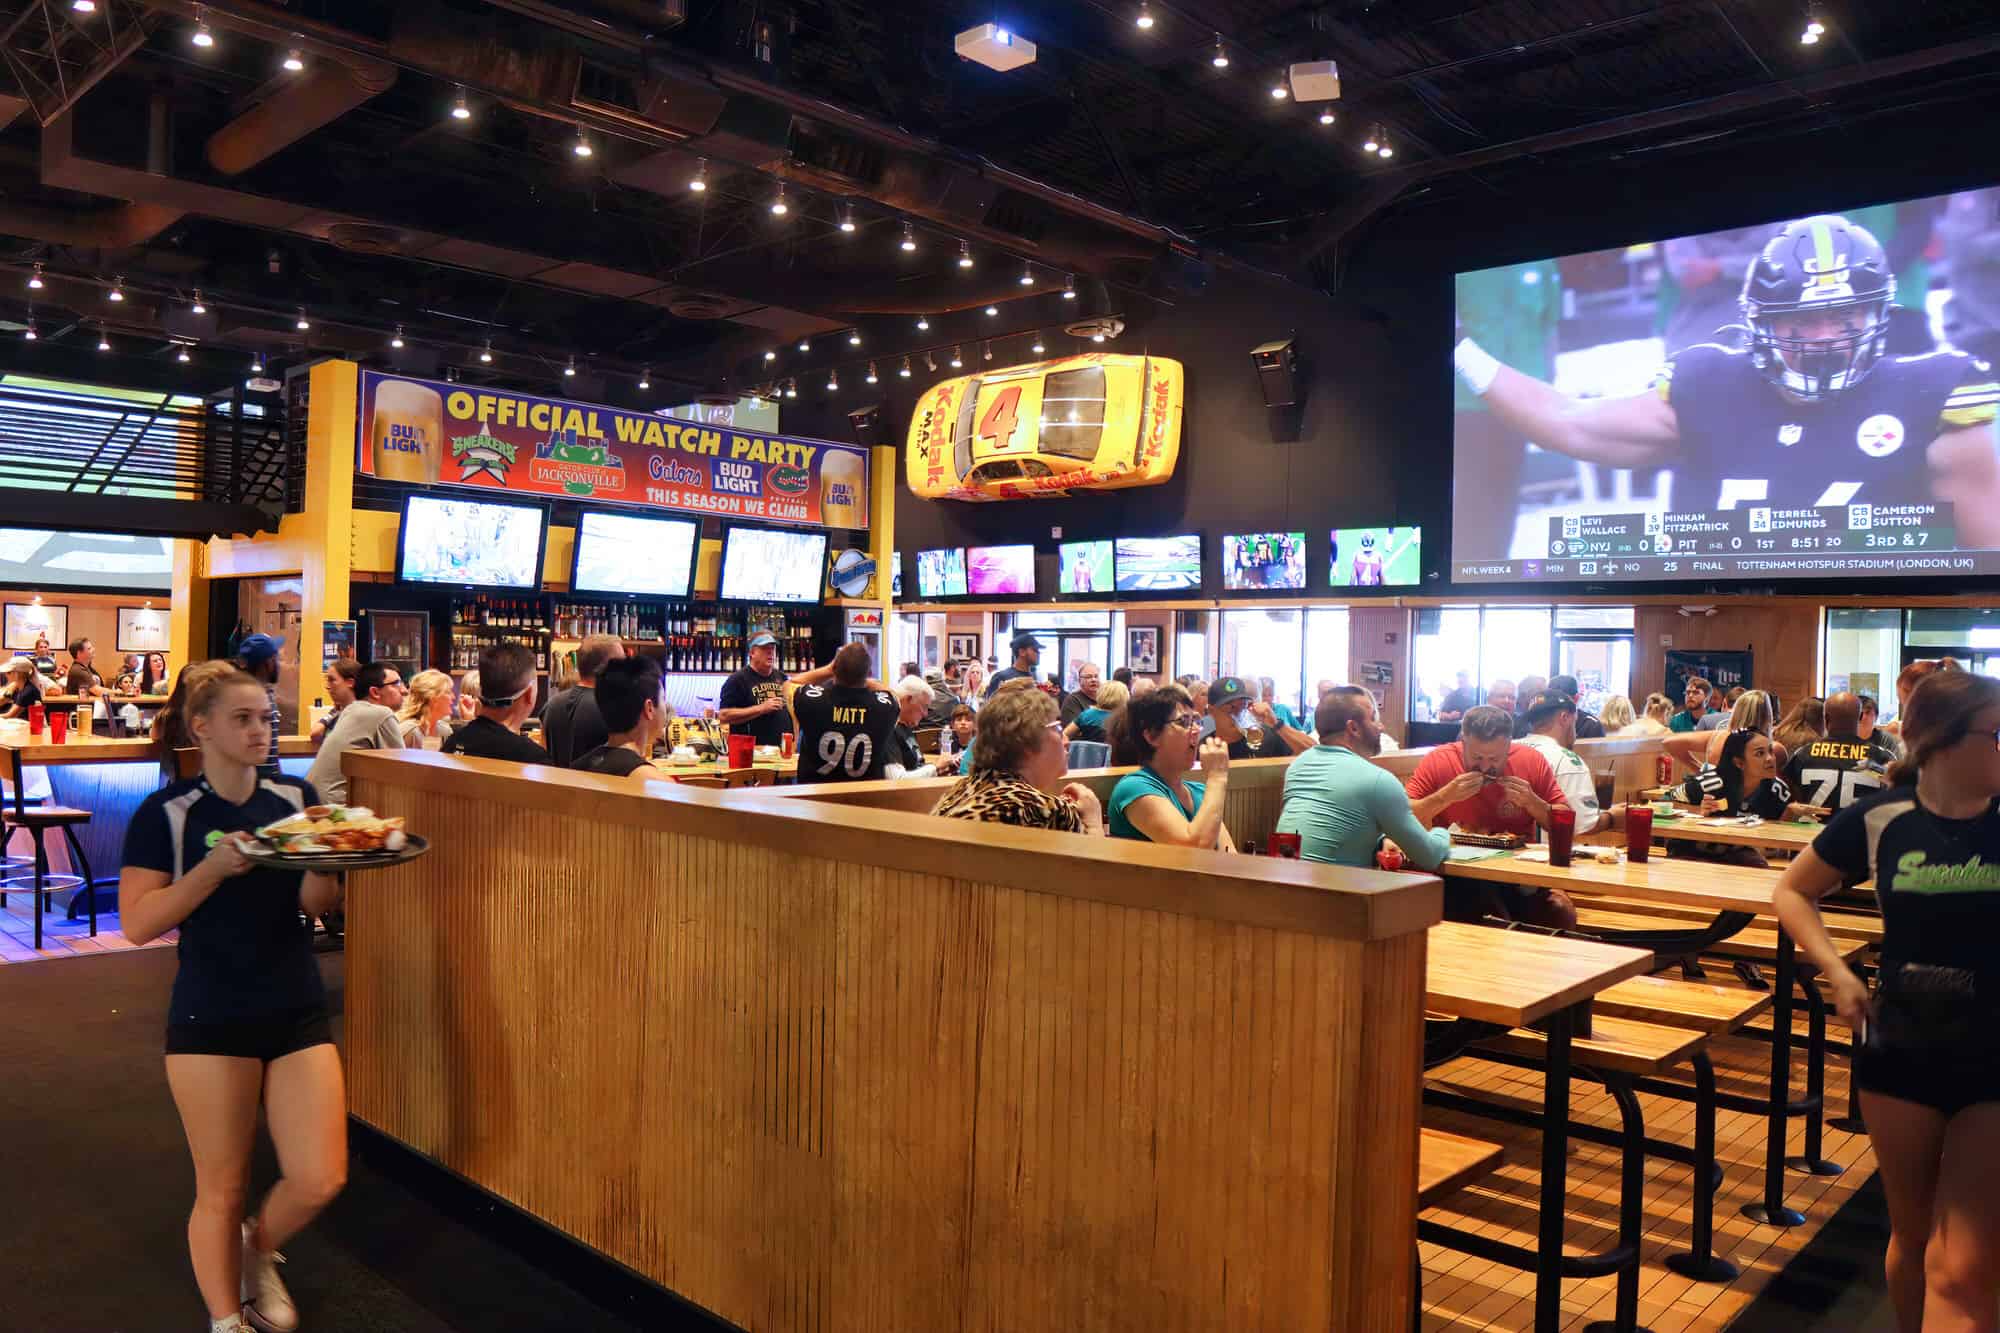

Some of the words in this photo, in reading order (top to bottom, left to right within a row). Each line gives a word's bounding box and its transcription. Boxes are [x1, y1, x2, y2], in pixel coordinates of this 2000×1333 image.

[980, 385, 1022, 448] 4
[1146, 380, 1169, 457] Kodak
[447, 391, 604, 439] OFFICIAL
[614, 415, 721, 456] WATCH
[731, 436, 816, 468] PARTY
[920, 411, 933, 458] MAX
[928, 386, 954, 488] Kodak
[452, 434, 516, 464] SNEAKERS
[537, 467, 619, 488] JACKSONVILLE
[649, 455, 702, 488] Gators
[719, 461, 753, 478] BUD
[1034, 467, 1097, 490] Kodak
[714, 475, 759, 493] LIGHT
[646, 487, 678, 504] THIS
[683, 490, 740, 511] SEASON
[744, 498, 764, 515] WE
[768, 503, 808, 519] CLIMB
[1873, 505, 1935, 516] CAMERON
[1582, 518, 1603, 526] LEVI
[1664, 514, 1706, 522] MINKAH
[1771, 510, 1820, 519] TERRELL
[1873, 516, 1921, 527] SUTTON
[1582, 526, 1627, 535] WALLACE
[1664, 522, 1729, 532] FITZPATRICK
[1772, 519, 1827, 529] EDMUNDS
[1589, 541, 1611, 552] NYJ
[1639, 539, 1649, 552] 0
[1678, 539, 1698, 550] PIT
[1730, 536, 1742, 549] 0
[1757, 539, 1776, 549] 1ST
[1791, 536, 1820, 548] 8:51
[1825, 537, 1841, 547] 20
[1865, 534, 1897, 547] 3RD
[1902, 533, 1915, 545] &
[1918, 533, 1928, 545] 7
[1478, 566, 1504, 575] WEEK
[1546, 564, 1564, 574] MIN
[1581, 563, 1595, 574] 28
[1624, 562, 1640, 572] NO
[1663, 562, 1678, 572] 25
[1693, 561, 1724, 571] FINAL
[1736, 560, 1797, 570] TOTTENHAM
[1798, 559, 1847, 569] HOTSPUR
[1848, 558, 1894, 568] STADIUM
[1896, 557, 1952, 569] (LONDON,
[1954, 557, 1974, 569] UK)
[832, 706, 867, 725] WATT
[816, 731, 873, 778] 90
[1810, 742, 1870, 760] GREENE
